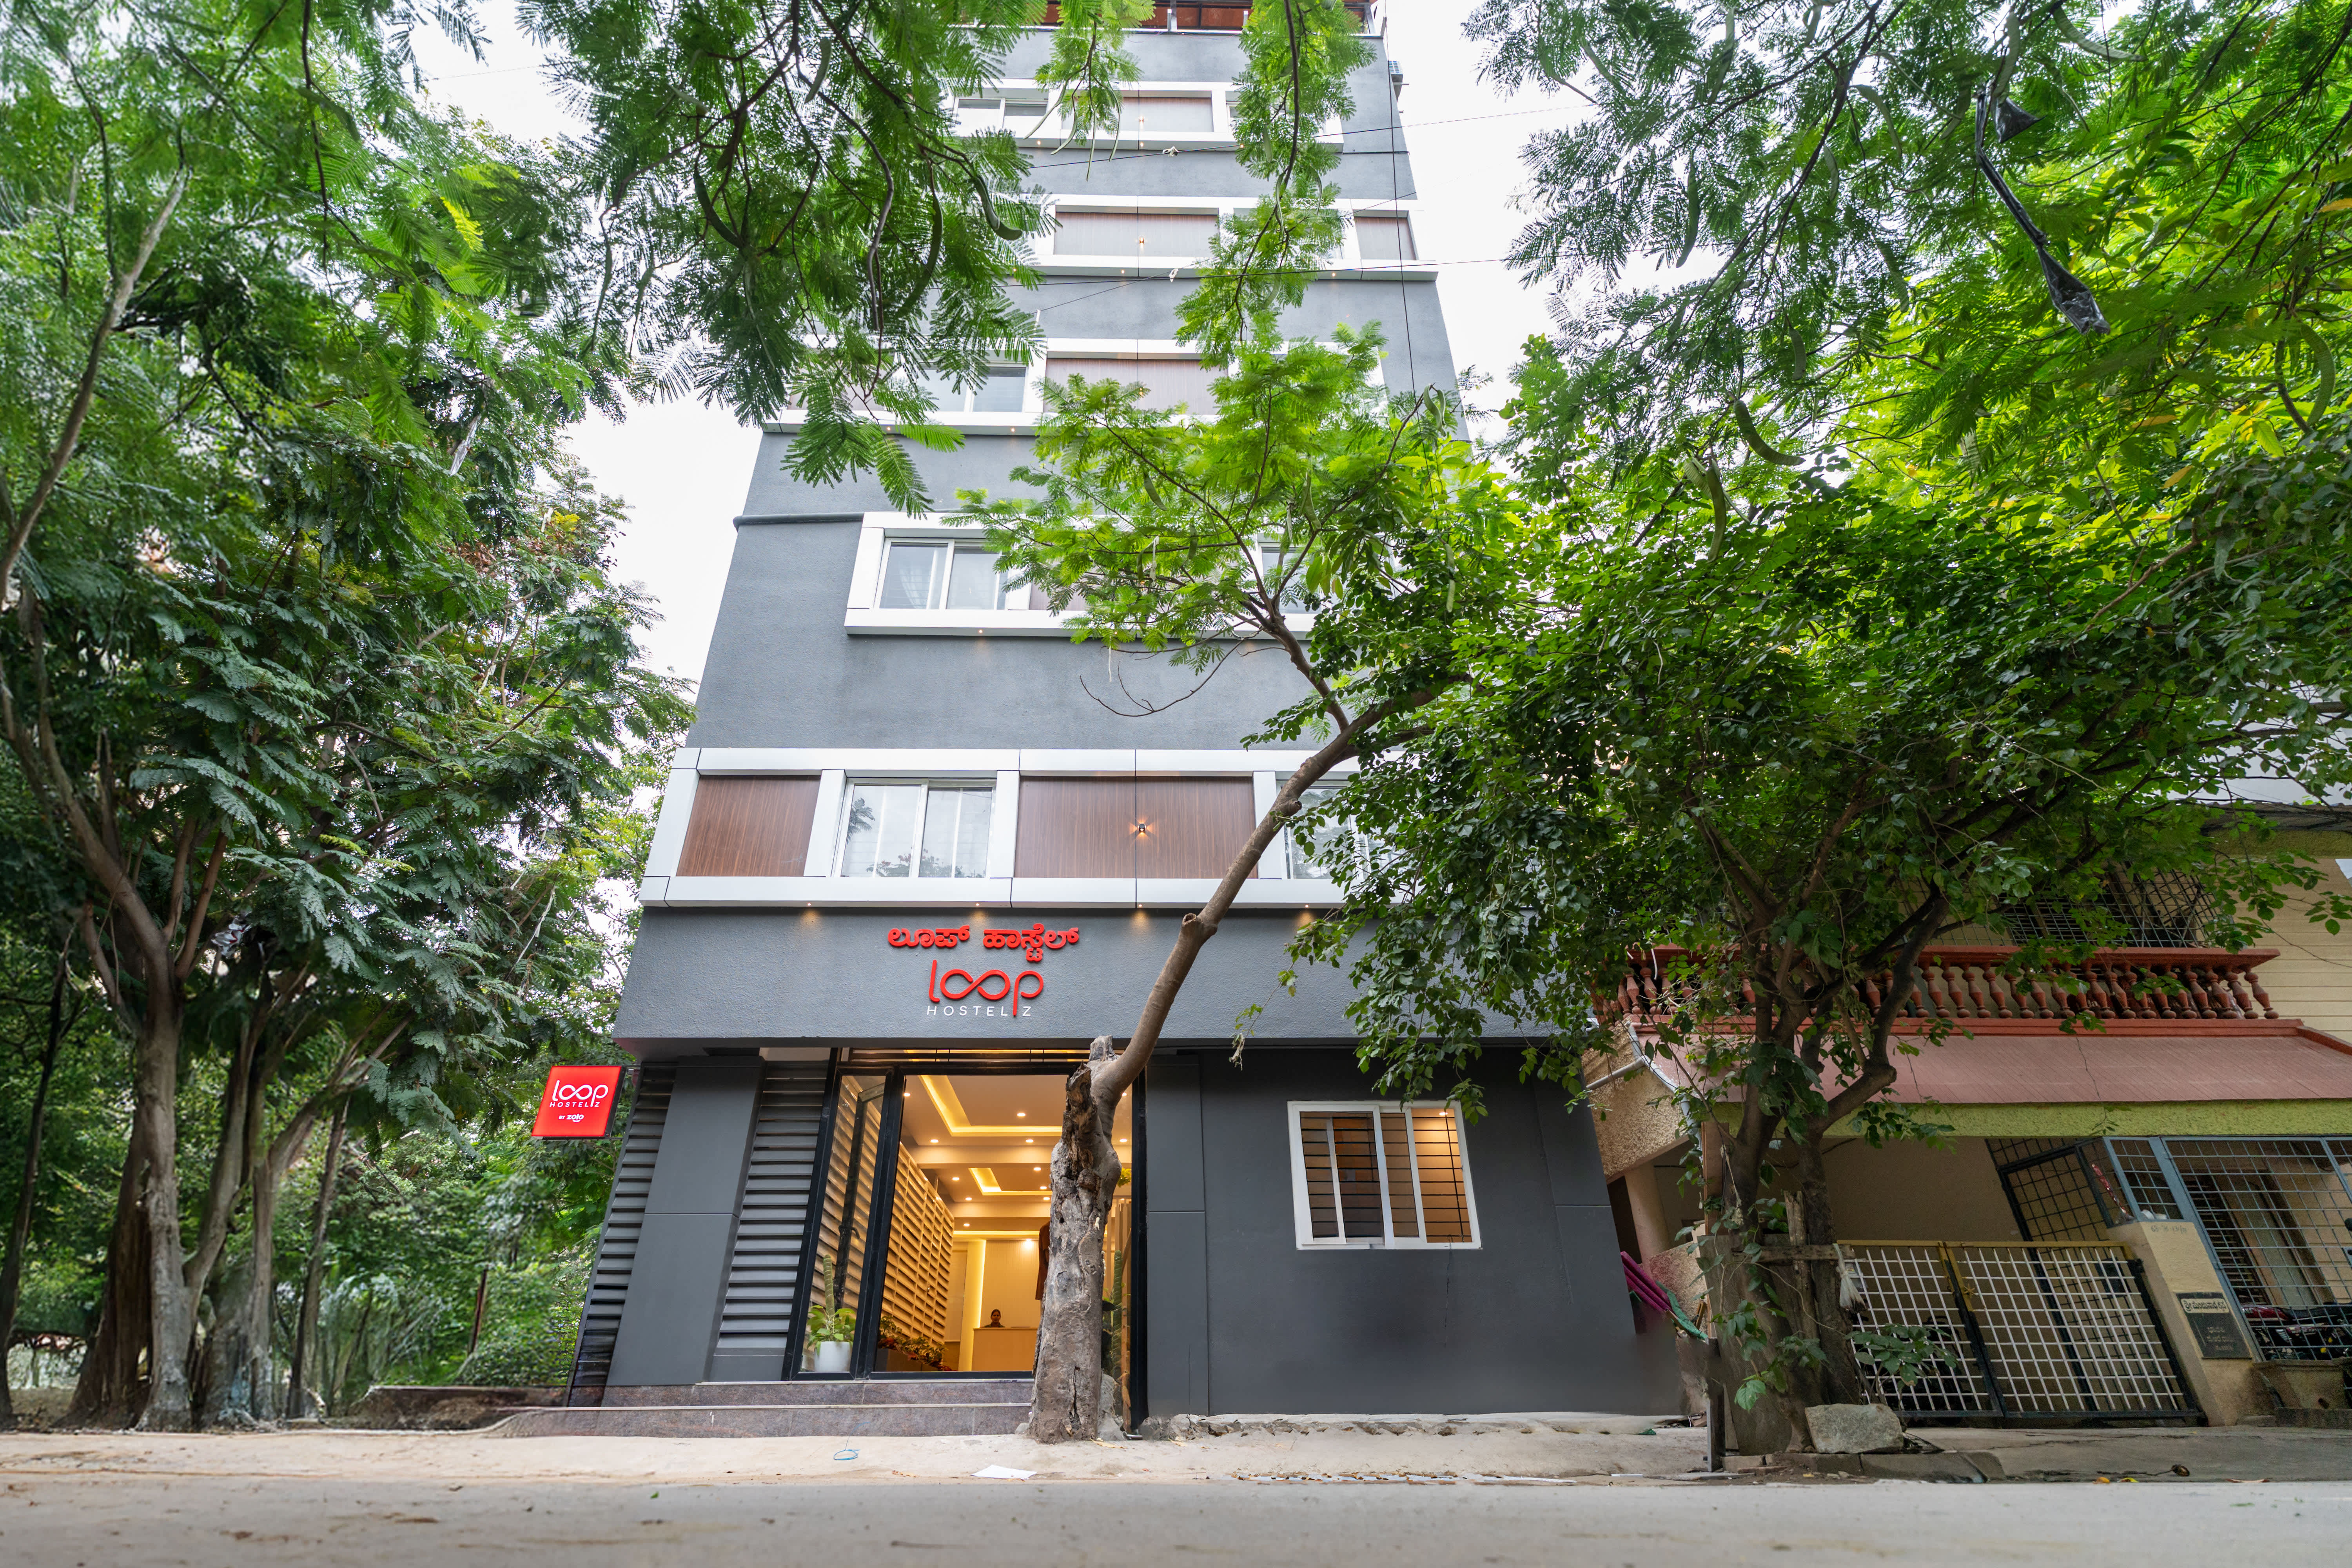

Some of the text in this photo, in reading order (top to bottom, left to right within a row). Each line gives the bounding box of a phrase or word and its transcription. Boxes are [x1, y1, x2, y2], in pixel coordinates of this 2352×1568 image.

[887, 923, 1079, 962] ಲೂಪ್ ಹಾಸ್ಟೆಲ್
[929, 959, 1044, 1016] loop
[552, 1080, 608, 1107] loop
